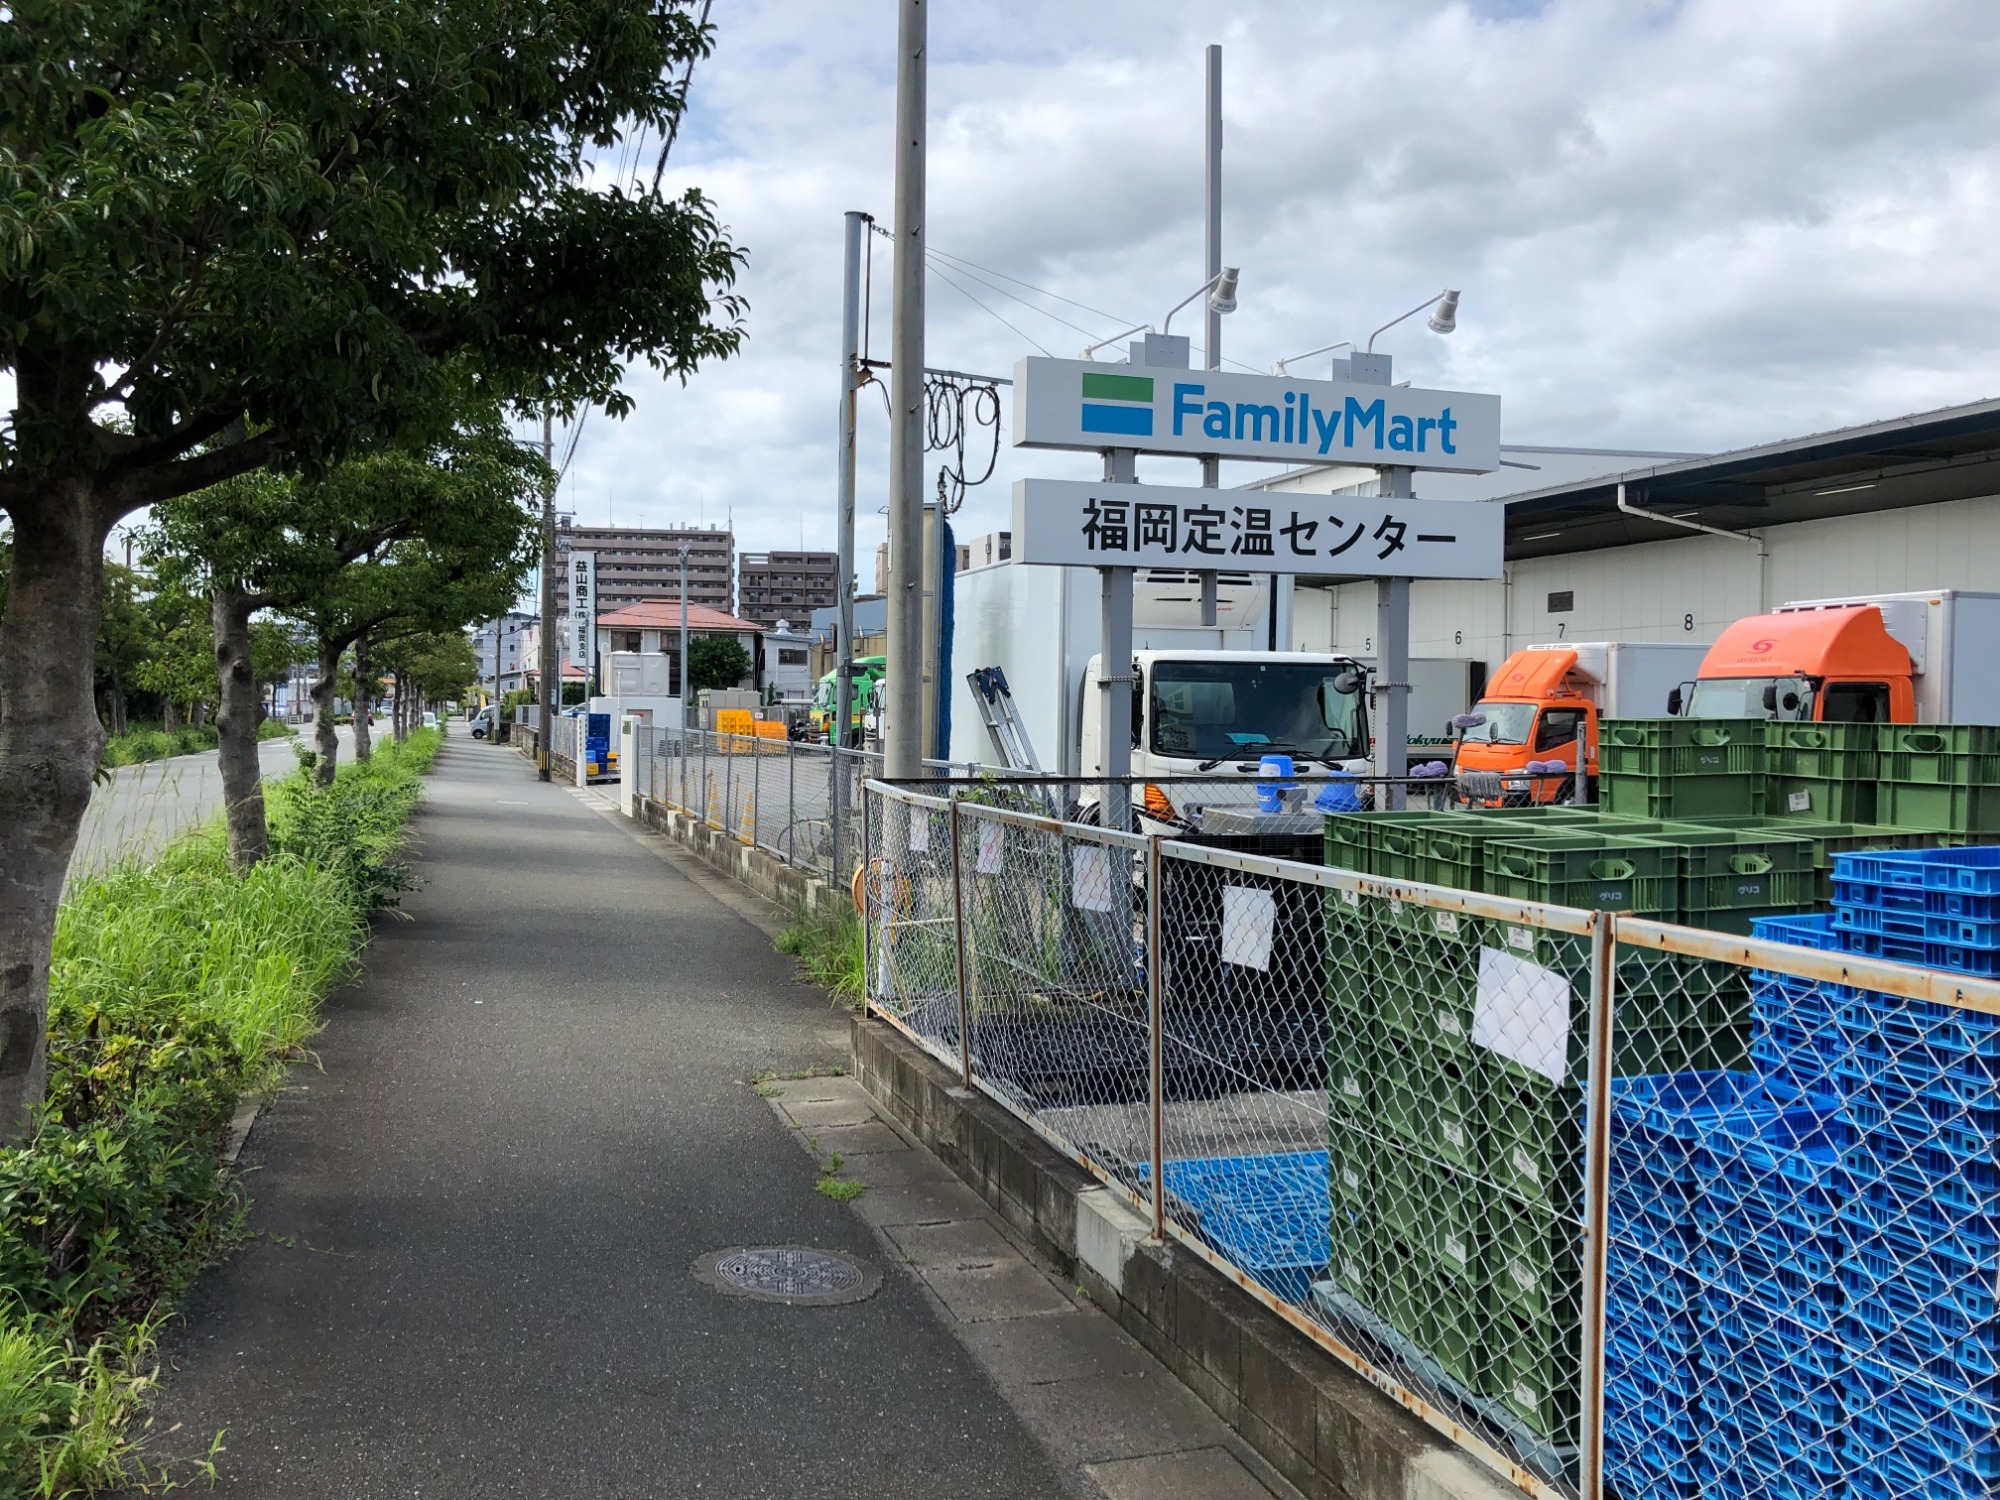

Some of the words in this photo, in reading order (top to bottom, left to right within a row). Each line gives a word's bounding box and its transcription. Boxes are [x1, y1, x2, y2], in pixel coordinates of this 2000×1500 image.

[1173, 383, 1457, 454] FamilyMart
[1081, 497, 1456, 560] 福岡定温センター
[1684, 614, 1693, 631] 8
[1455, 631, 1462, 645] 6
[1558, 623, 1566, 639] 7
[1365, 638, 1371, 651] 5
[1599, 892, 1622, 900] グリコ
[1738, 885, 1760, 894] グリコ
